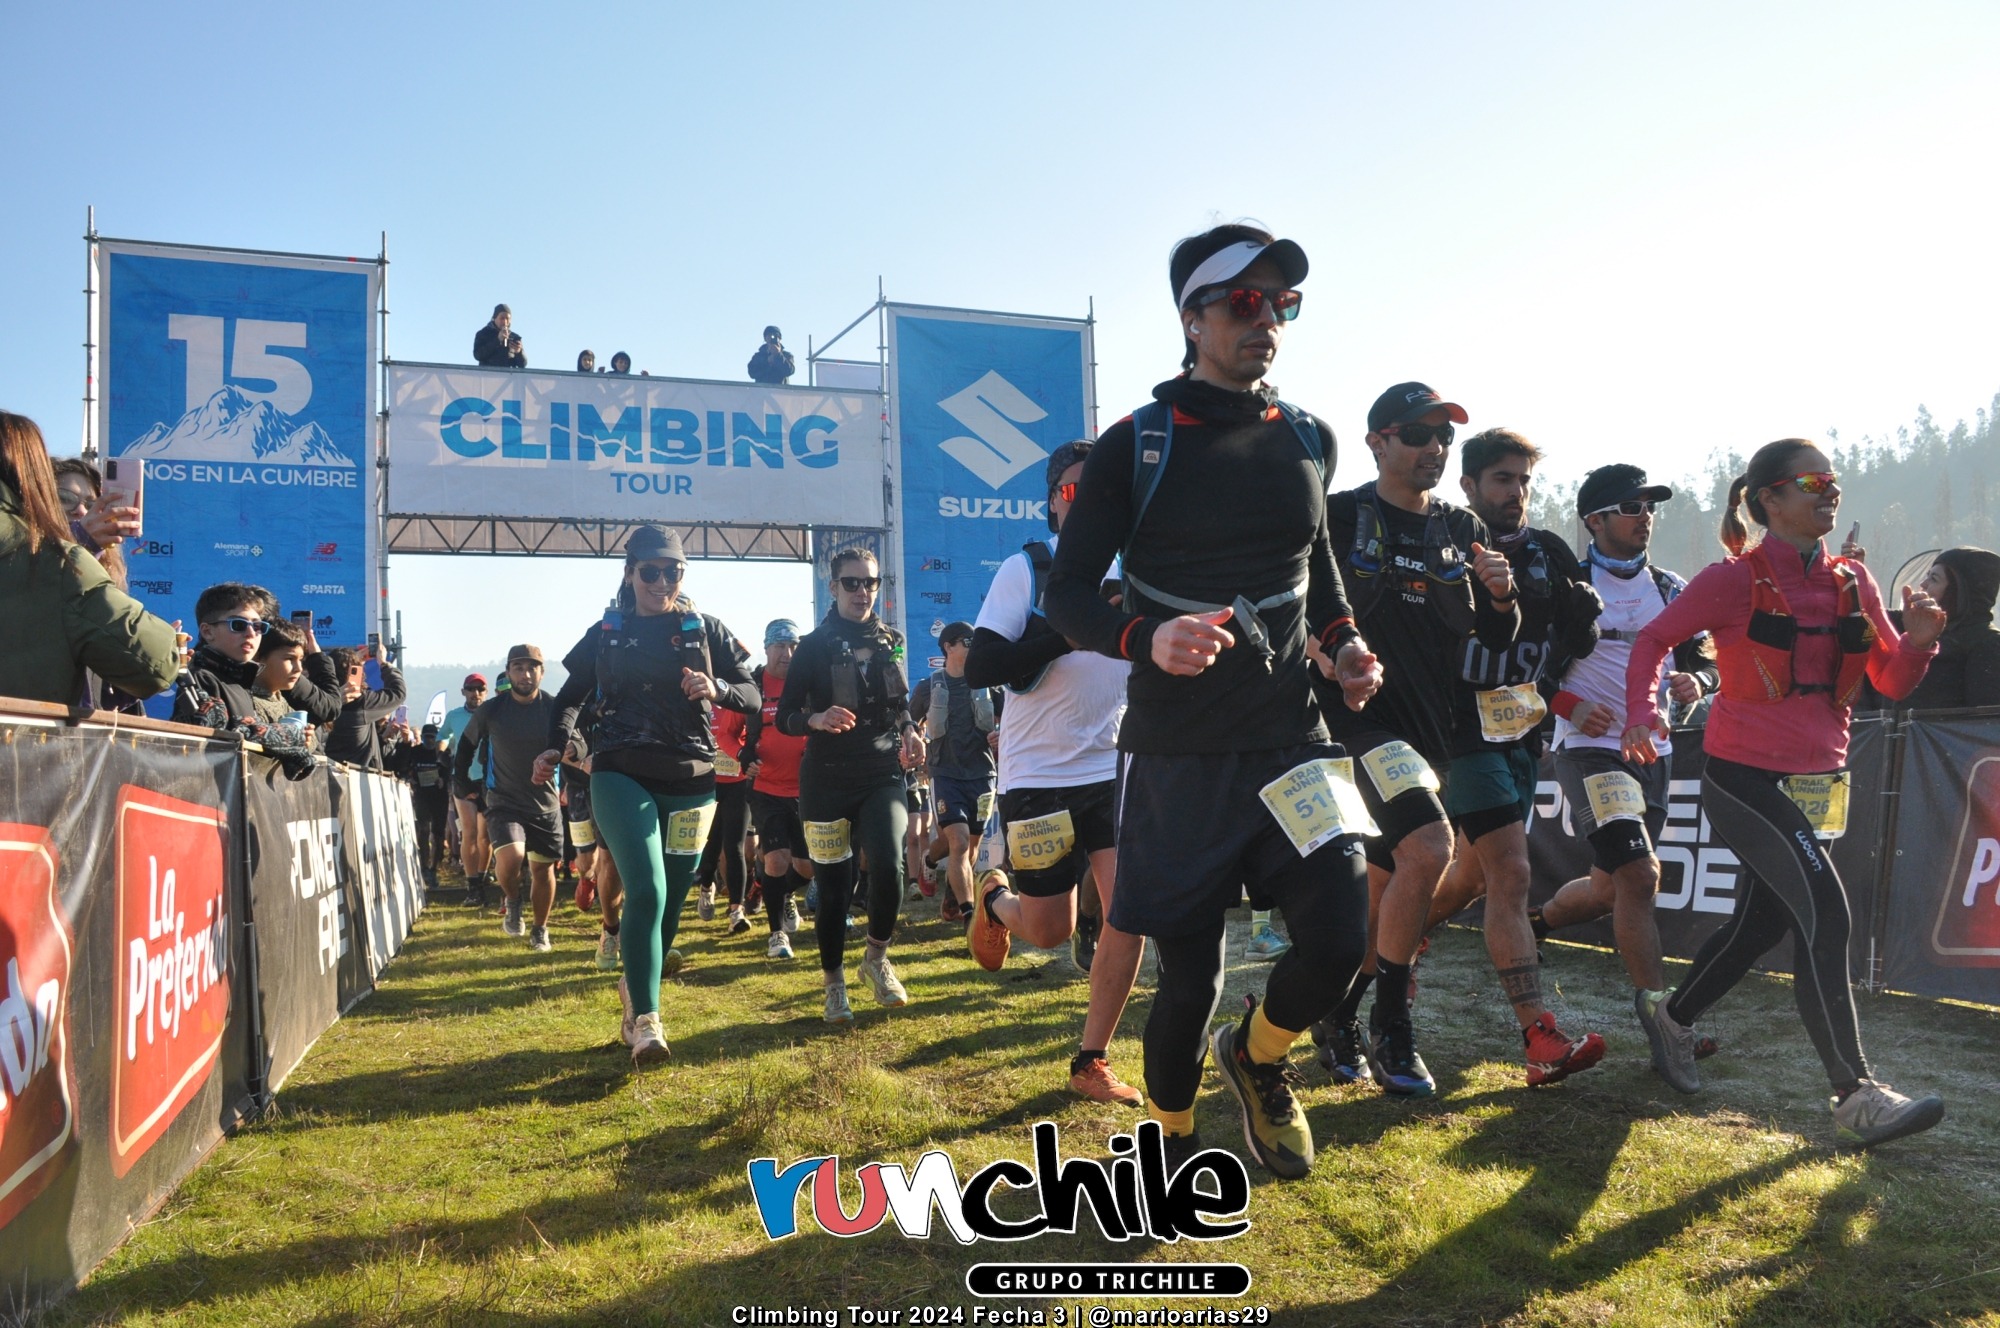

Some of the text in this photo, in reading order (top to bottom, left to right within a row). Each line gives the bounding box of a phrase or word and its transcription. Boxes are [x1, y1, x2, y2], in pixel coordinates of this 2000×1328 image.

[168, 313, 313, 417] 15
[440, 397, 839, 469] CLIMBING
[144, 460, 358, 488] ÑOS EN LA CUMBRE
[610, 472, 692, 496] TOUR
[939, 496, 1047, 520] SUZUK
[149, 541, 174, 555] Bci
[225, 549, 250, 557] SPORT
[933, 559, 952, 571] Bci
[148, 587, 173, 595] ADE
[302, 584, 345, 595] SPARTA
[1401, 593, 1425, 604] TOUR
[1492, 704, 1536, 722] 5095
[1386, 762, 1425, 780] 504
[1795, 799, 1830, 815] 026
[1017, 824, 1061, 840] RUNNING
[1023, 820, 1051, 831] TRAIL
[811, 837, 842, 849] 5080
[1020, 837, 1066, 858] 5031
[149, 855, 176, 941] La
